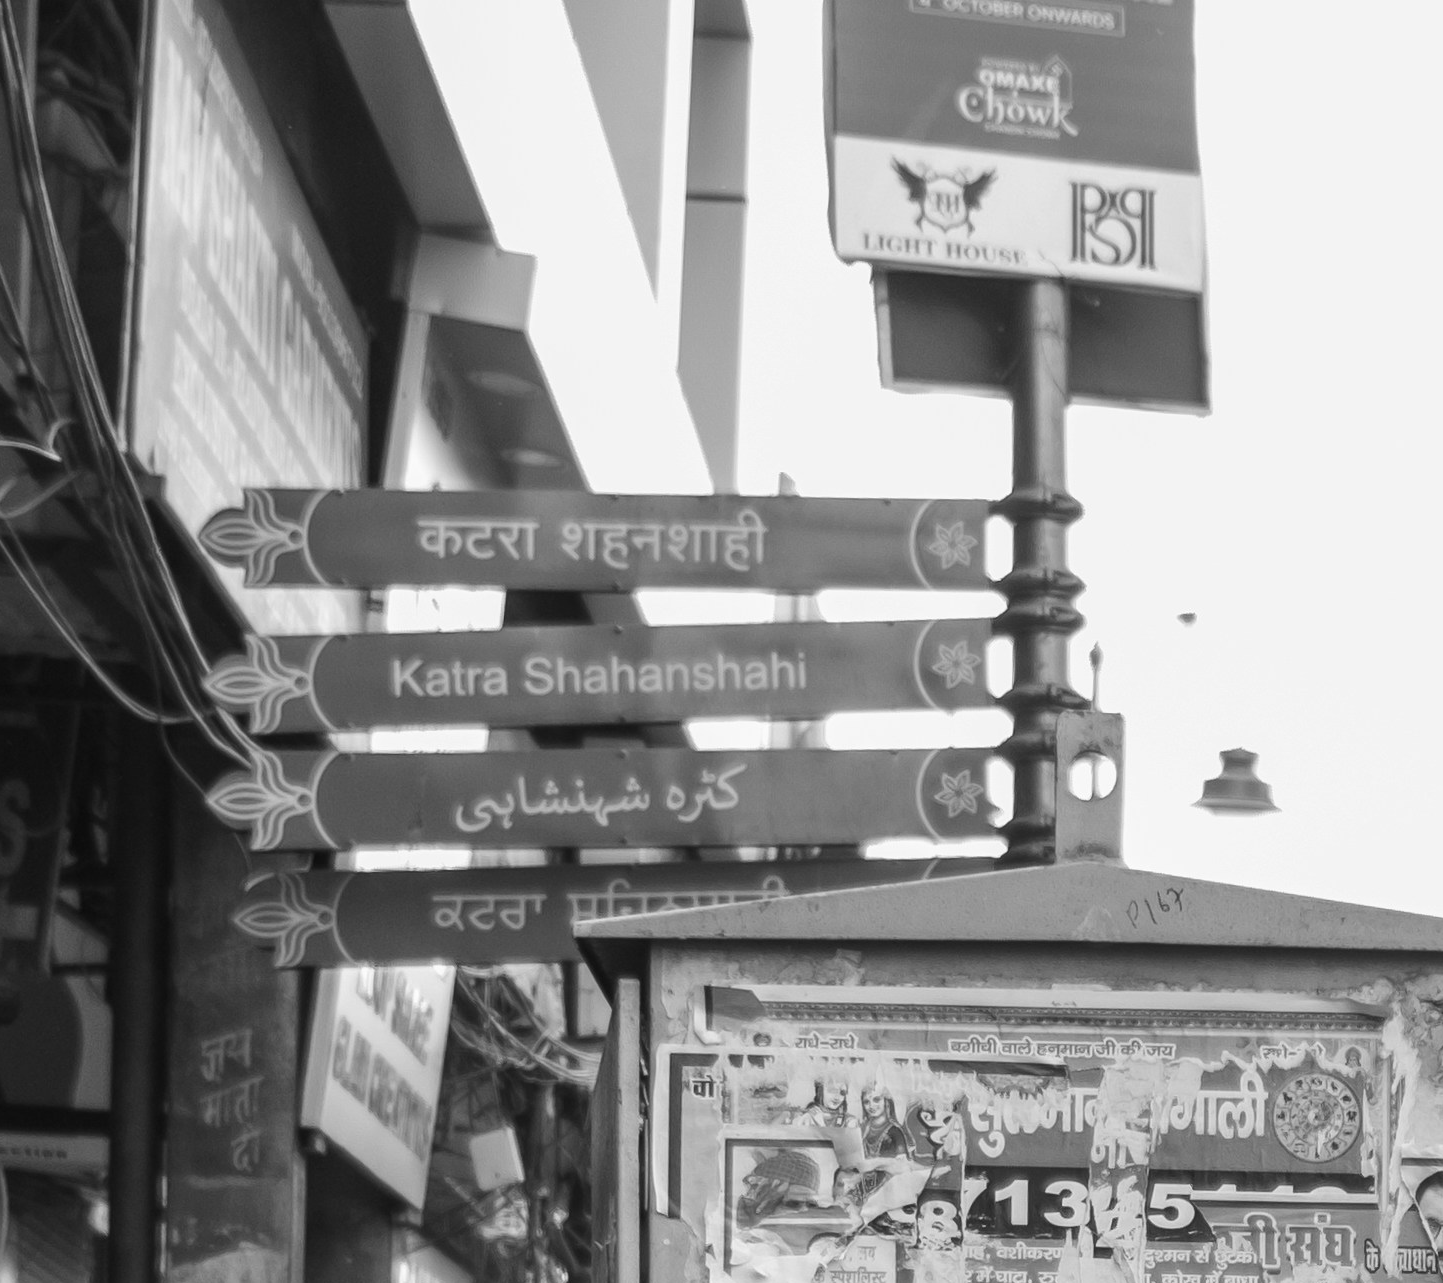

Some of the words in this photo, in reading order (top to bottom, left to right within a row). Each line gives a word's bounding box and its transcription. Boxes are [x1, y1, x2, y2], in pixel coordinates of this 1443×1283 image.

[1026, 4, 1116, 32] ONWARDS
[978, 68, 1060, 93] OMAXE
[958, 78, 1080, 138] Chowk
[862, 232, 937, 257] LIGHT
[945, 242, 1027, 265] HOUSE
[417, 517, 540, 561] कटरा
[560, 509, 769, 571] शहनशाही
[391, 658, 509, 698] Katra
[523, 652, 808, 696] Shahanshahi
[432, 893, 547, 932] ਕਟਰਾ
[795, 1031, 858, 1050] राधे-राधे
[1095, 1037, 1116, 1058] जी
[1146, 1043, 1174, 1060] जय
